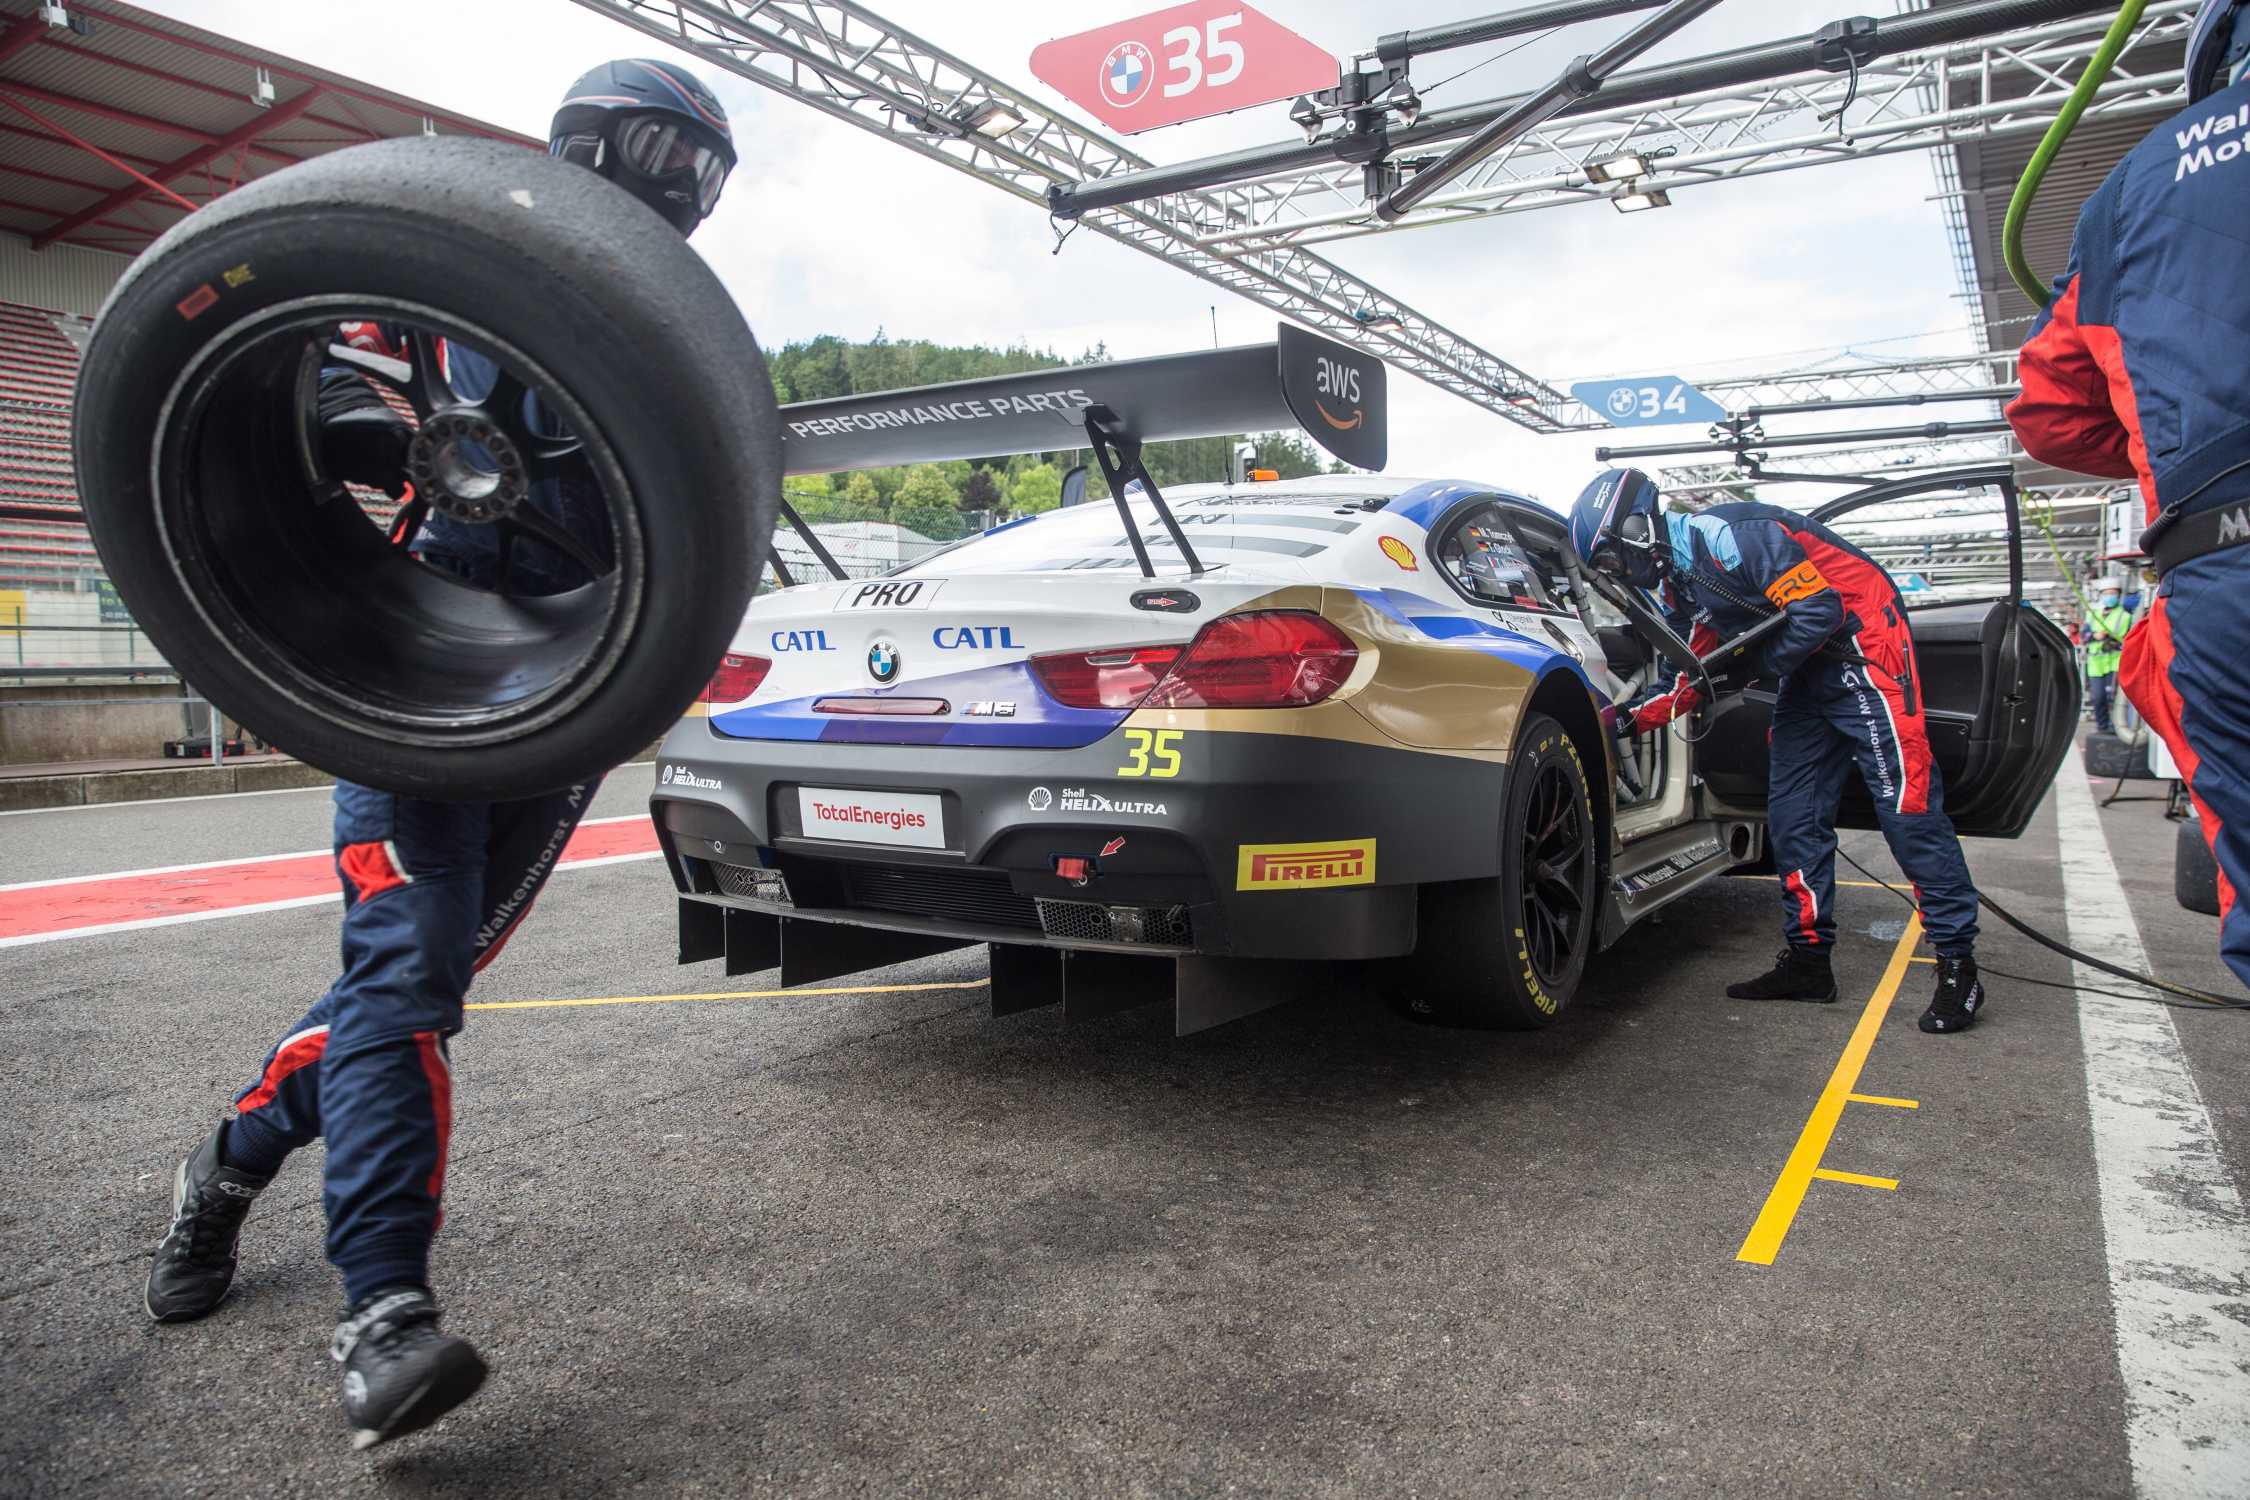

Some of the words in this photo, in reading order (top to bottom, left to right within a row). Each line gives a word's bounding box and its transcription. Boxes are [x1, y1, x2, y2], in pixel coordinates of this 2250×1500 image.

[1107, 45, 1146, 67] BMW
[1164, 12, 1244, 98] 35
[1317, 357, 1360, 403] aws
[788, 400, 993, 438] PERFORMANCE
[989, 389, 1094, 415] PARTS
[1639, 384, 1687, 418] 34
[2217, 505, 2250, 545] M
[851, 581, 925, 608] PRO
[771, 630, 837, 651] CATL
[932, 626, 1025, 649] CATL
[1117, 729, 1185, 778] 35
[695, 777, 722, 790] ULTRA
[1062, 787, 1085, 798] Shell
[813, 802, 926, 830] TotalEnergies
[1060, 795, 1114, 812] HELIX
[1114, 802, 1168, 815] ULTRA
[1251, 849, 1366, 882] PIRELLI
[475, 819, 570, 947] Walkenhorst
[1515, 928, 1558, 1015] PIRELLI
